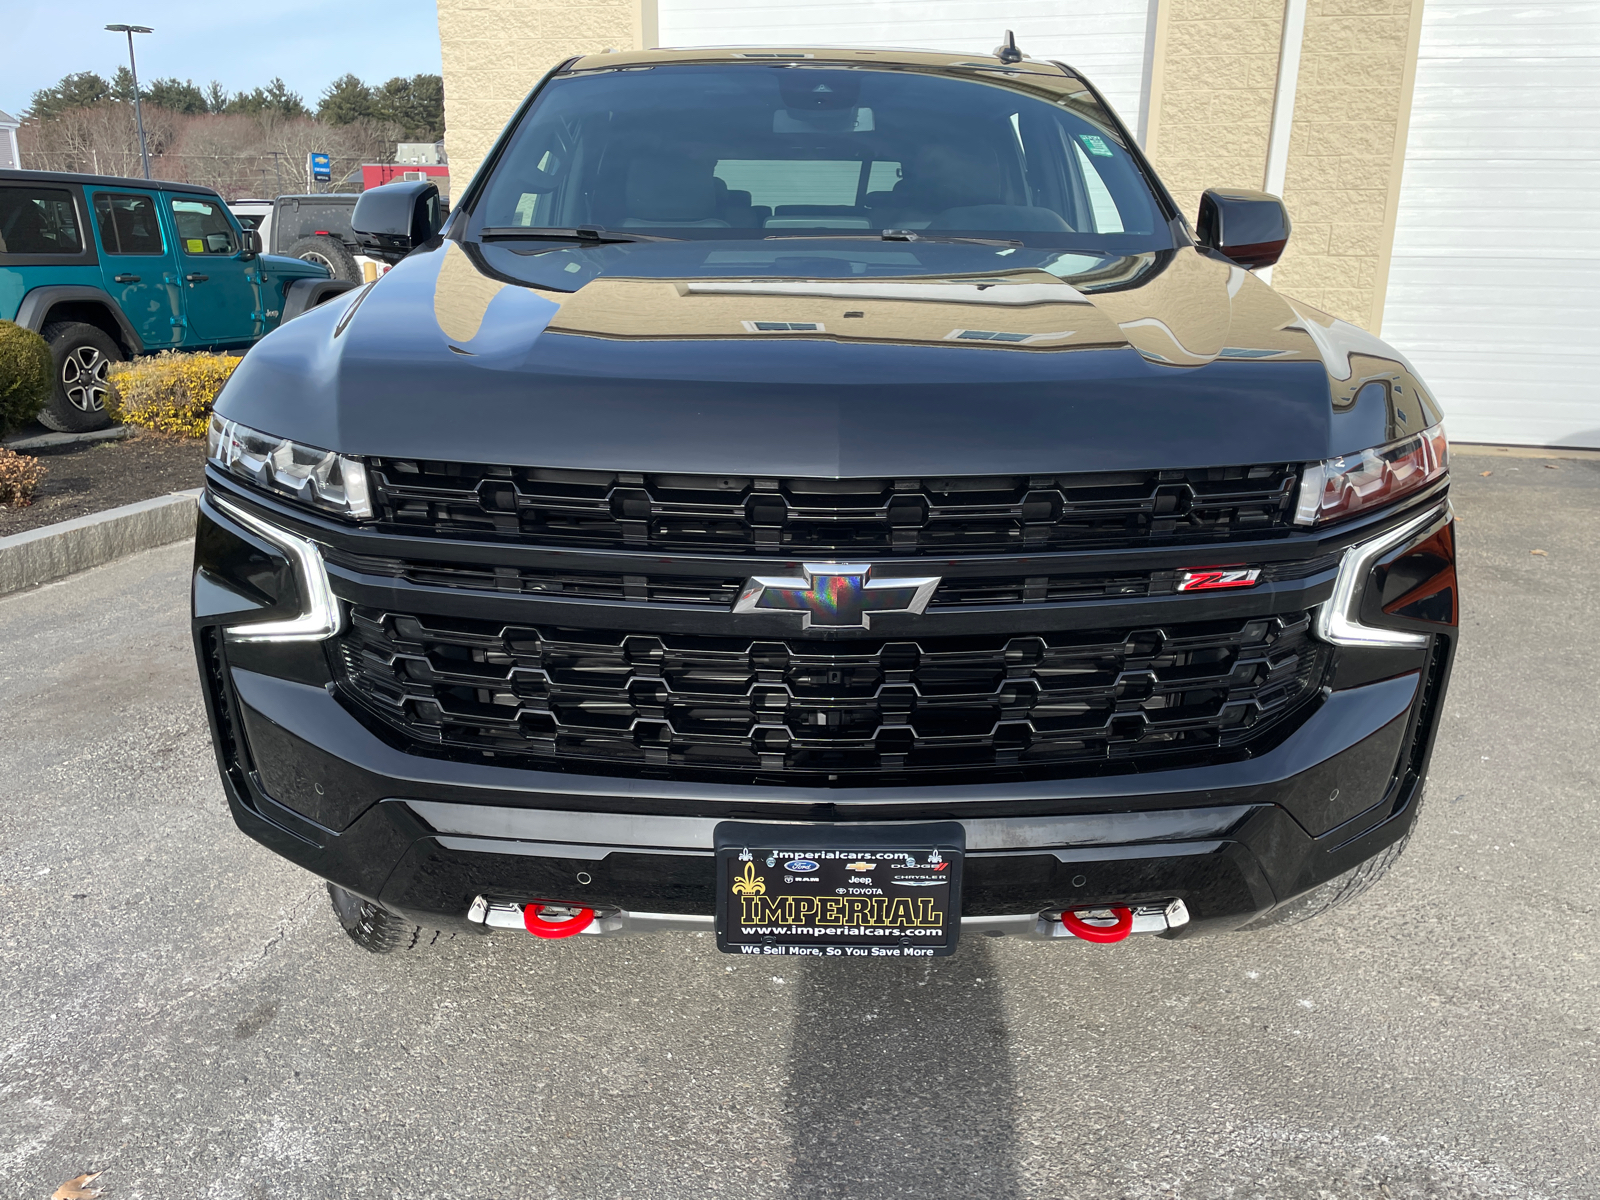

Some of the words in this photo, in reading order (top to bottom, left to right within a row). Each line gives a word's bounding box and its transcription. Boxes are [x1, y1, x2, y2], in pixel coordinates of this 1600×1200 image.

[772, 850, 909, 860] Imperialcars.com
[791, 862, 812, 870] Ford
[848, 876, 872, 885] Jeep
[741, 896, 943, 926] IMPERIAL
[741, 925, 943, 936] www.imperialcars.com
[741, 946, 761, 954] We
[763, 946, 785, 955] Sell
[789, 946, 823, 956] More,
[826, 947, 842, 956] So
[845, 948, 868, 956] You
[871, 948, 900, 956] Save
[904, 948, 934, 956] More
